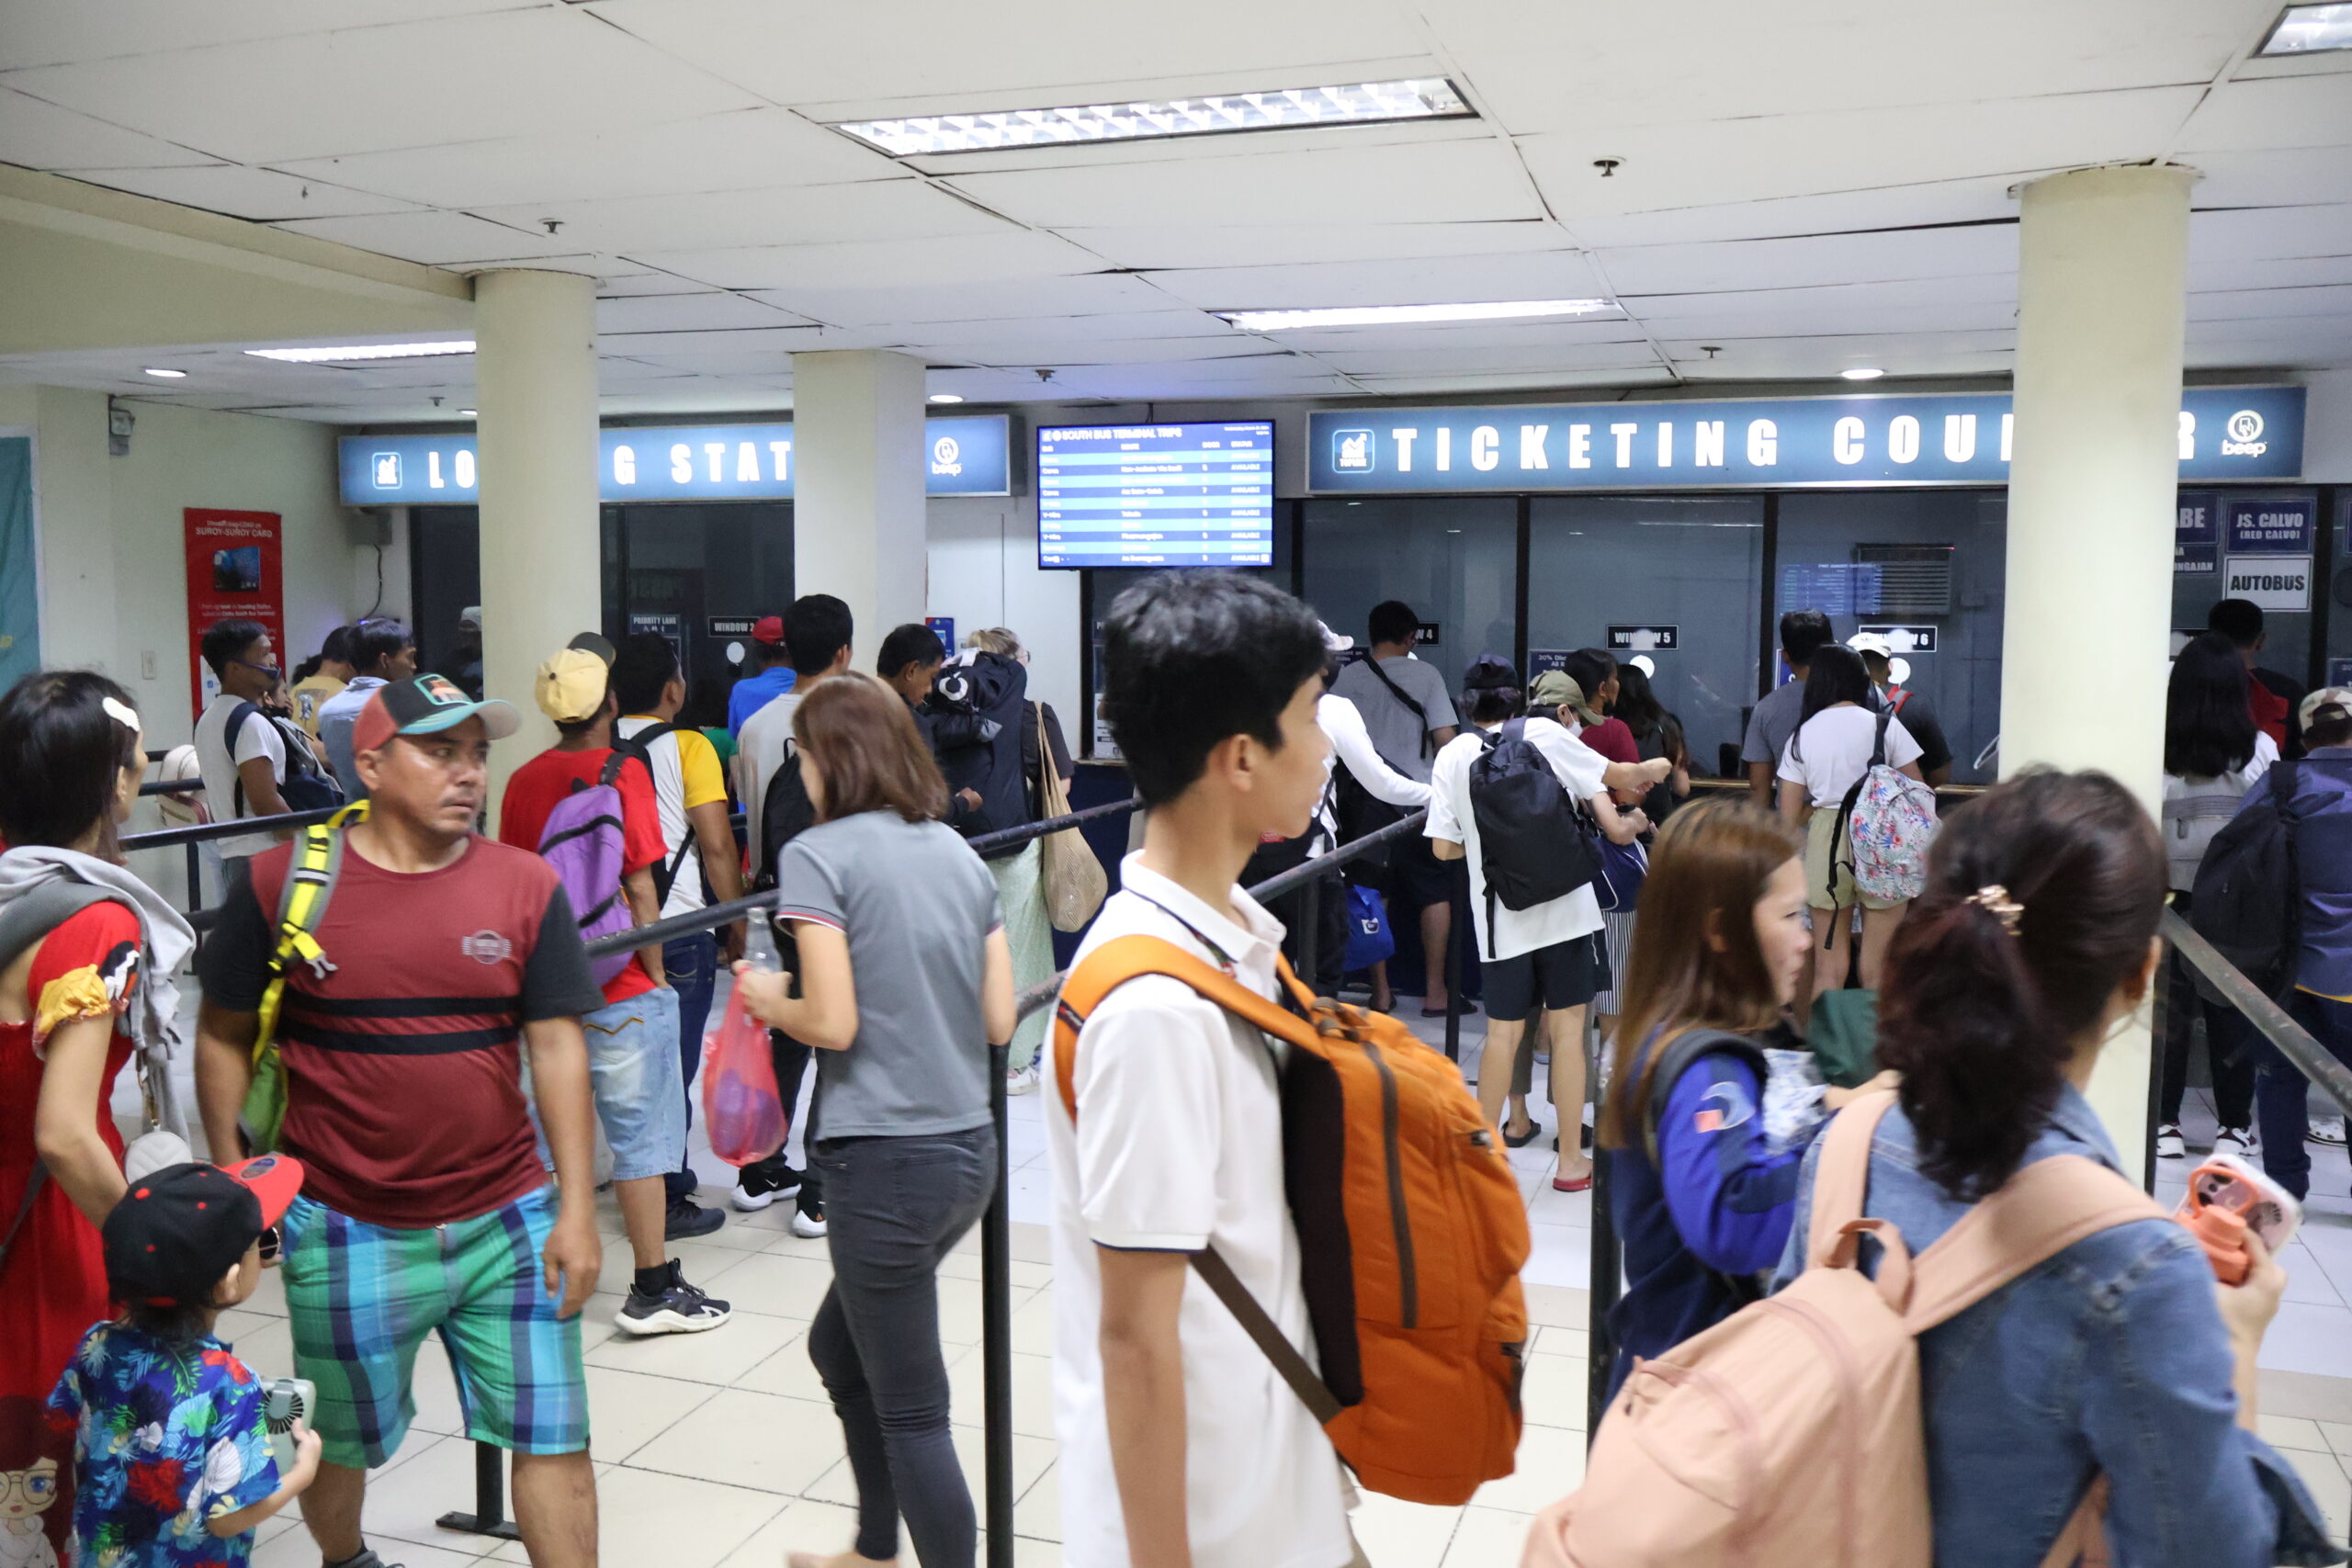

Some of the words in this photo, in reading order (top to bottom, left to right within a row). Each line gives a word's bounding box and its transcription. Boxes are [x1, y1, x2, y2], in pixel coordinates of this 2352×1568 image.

[1062, 430, 1092, 441] SOUTH
[1093, 429, 1112, 440] BUS
[1113, 428, 1156, 439] TERMINAL
[1157, 427, 1182, 438] TRIPS
[1391, 419, 1779, 472] TICKETING
[1833, 412, 2196, 466] COUR
[2222, 439, 2267, 458] beep
[671, 442, 793, 485] STAT
[2176, 507, 2206, 528] BE
[2258, 513, 2304, 527] CALVO
[251, 528, 273, 538] CARD
[2231, 575, 2304, 591] AUTOBUS
[633, 616, 661, 625] PRIORITY
[662, 616, 677, 625] LANE
[714, 622, 749, 632] WINDOW
[1426, 628, 1433, 640] 4
[1663, 632, 1671, 643] 5
[1920, 633, 1928, 646] 6
